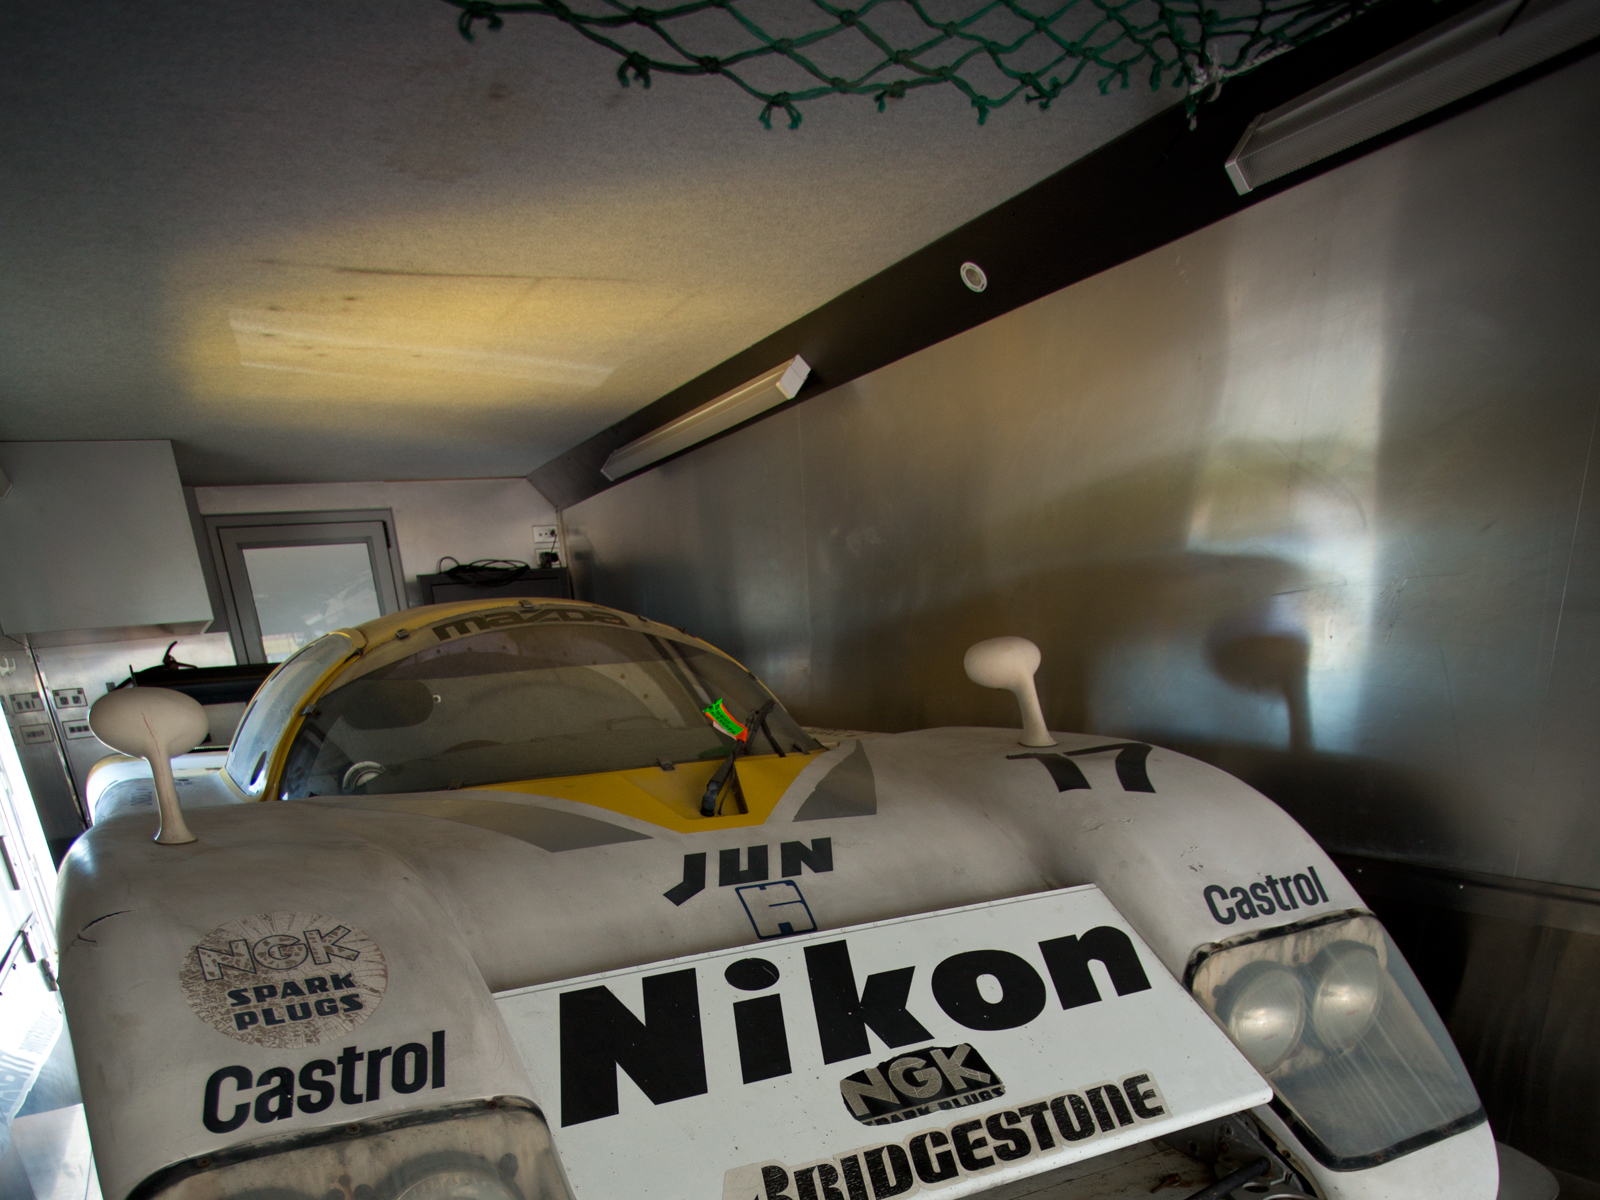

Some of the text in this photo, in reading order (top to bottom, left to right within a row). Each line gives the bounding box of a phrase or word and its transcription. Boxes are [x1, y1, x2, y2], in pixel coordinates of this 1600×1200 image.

[662, 836, 834, 907] JUN
[1203, 865, 1330, 926] Castrol
[195, 924, 361, 982] NGK
[226, 972, 357, 1008] SPARK
[232, 992, 364, 1031] PLUGS
[558, 925, 1153, 1129] Nikon
[202, 1029, 446, 1135] Castrol
[840, 1042, 992, 1117] NGK
